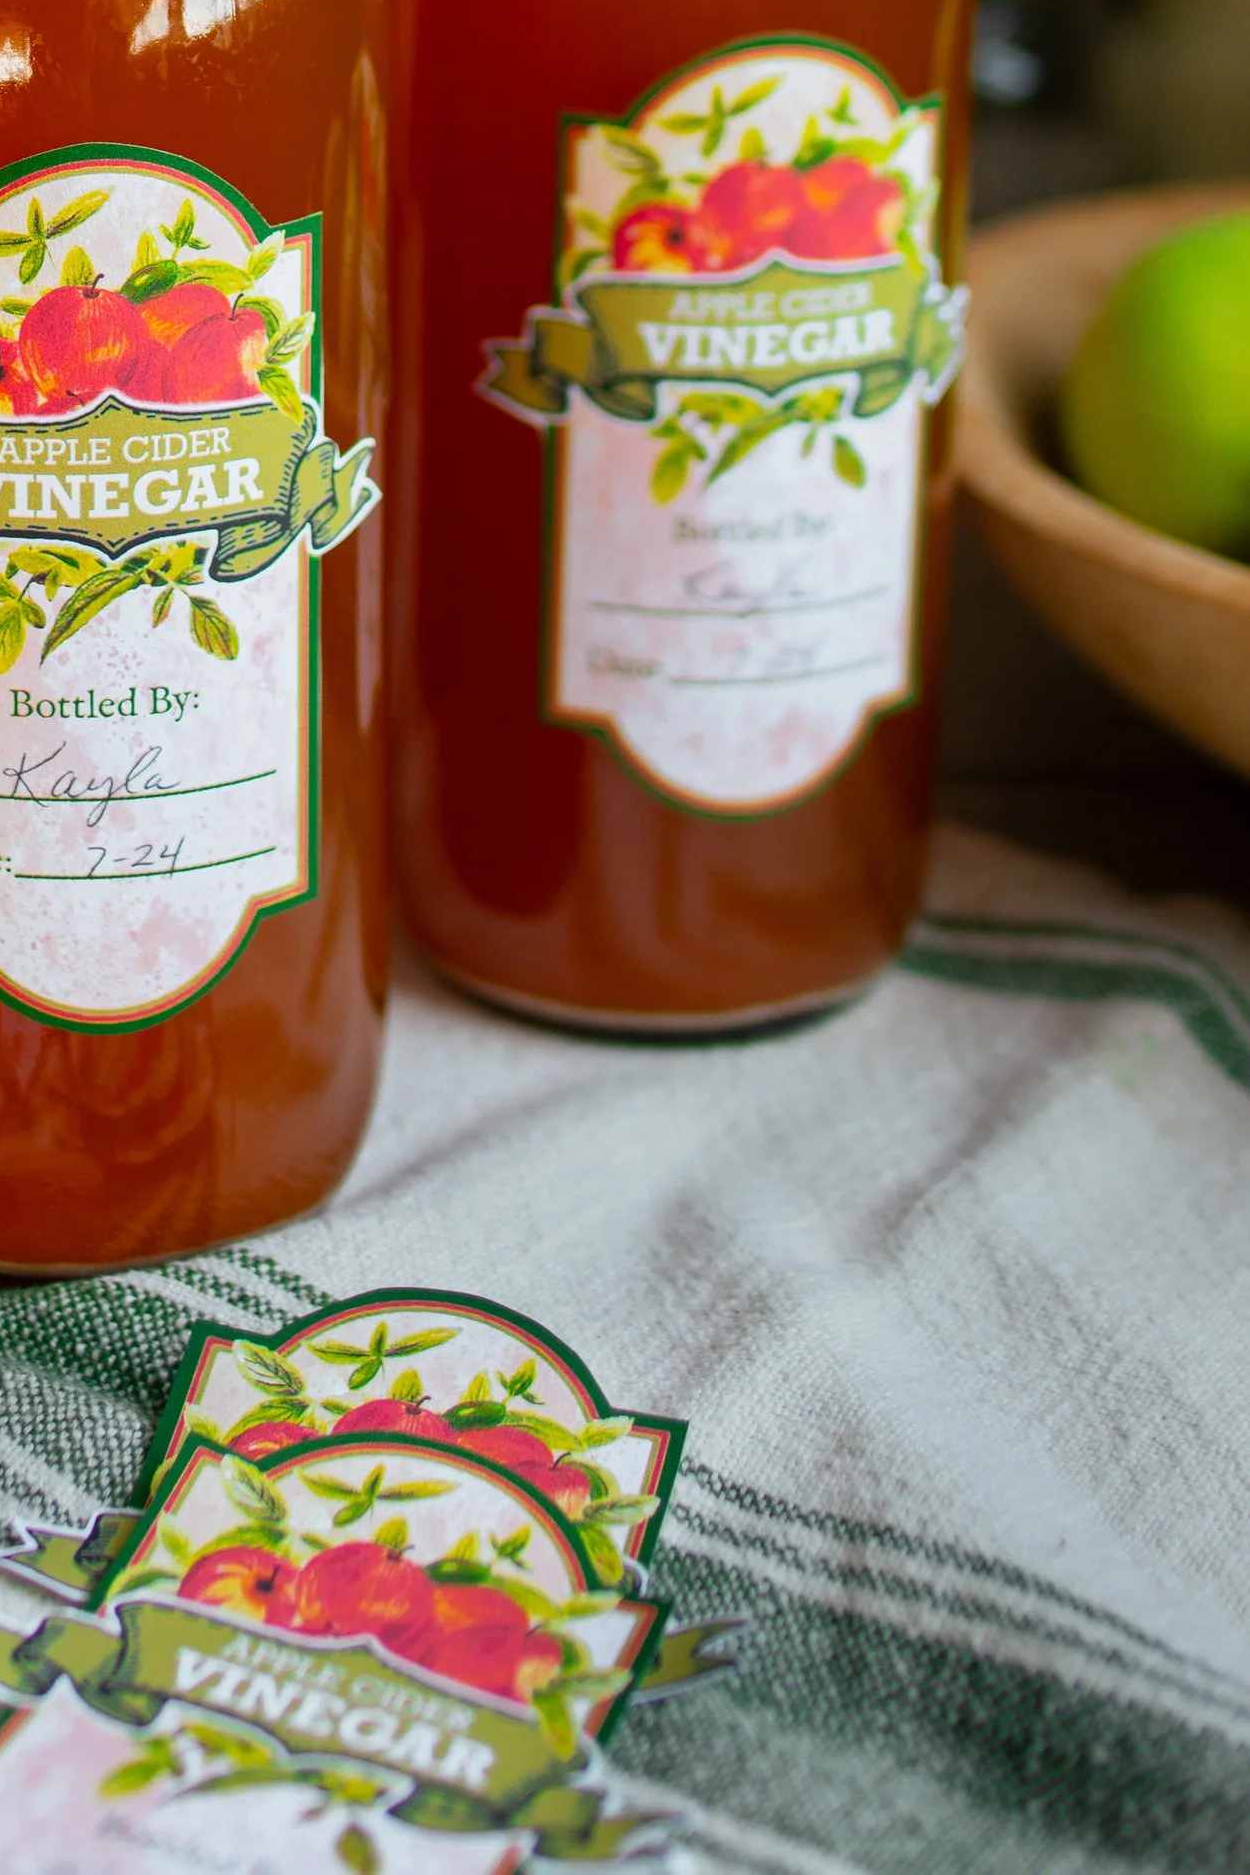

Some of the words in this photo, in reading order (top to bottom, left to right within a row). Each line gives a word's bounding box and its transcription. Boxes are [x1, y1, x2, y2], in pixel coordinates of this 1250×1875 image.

[669, 291, 777, 320] APPLE
[638, 309, 895, 368] VINEGAR
[122, 427, 232, 464] CIDER
[10, 687, 137, 719] Bottled
[149, 686, 200, 722] By:
[3, 741, 181, 828] Kayla
[86, 836, 186, 878] 7-24
[175, 1646, 496, 1790] VINEGAR
